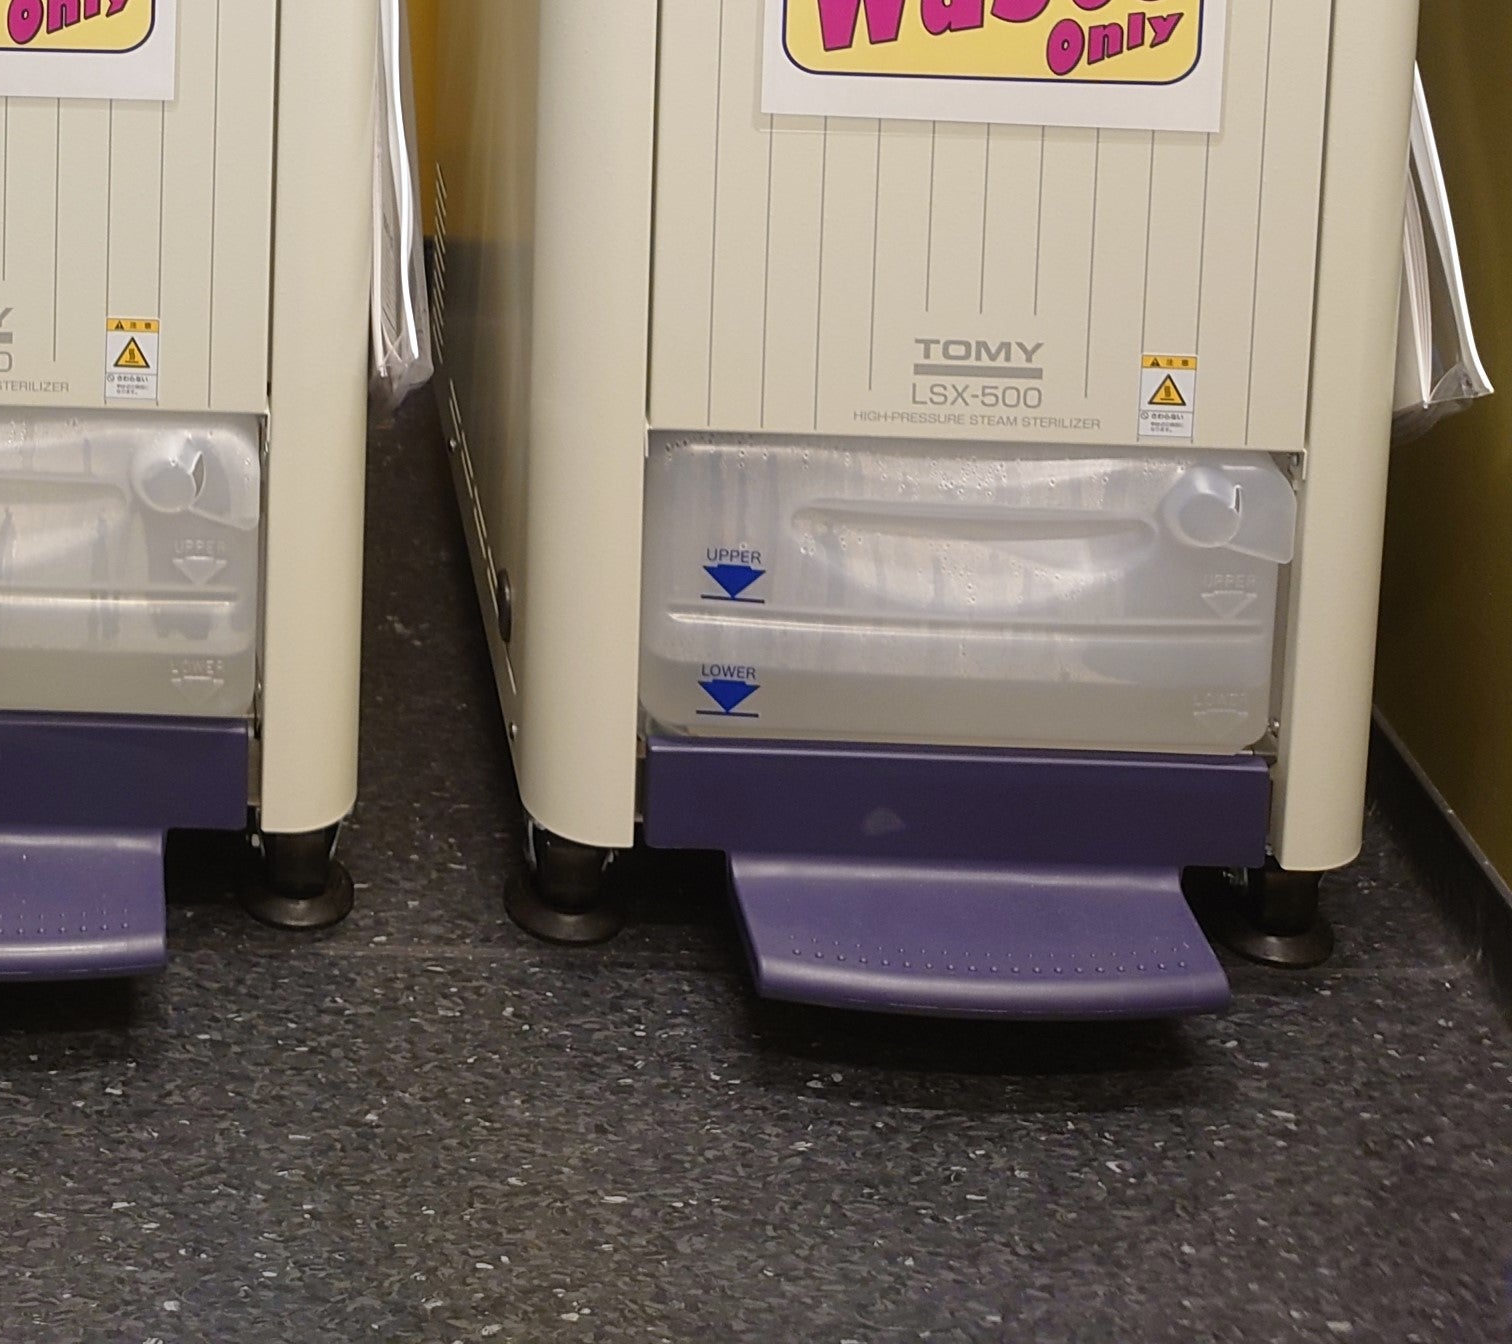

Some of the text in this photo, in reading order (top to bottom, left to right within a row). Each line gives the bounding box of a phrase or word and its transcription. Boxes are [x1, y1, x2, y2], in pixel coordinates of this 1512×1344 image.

[1046, 12, 1184, 76] Only
[914, 338, 1044, 364] TOMY
[912, 383, 1043, 408] LSX-500
[854, 411, 1101, 429] HIGH-PRESSURE STEAM STERILIZER
[707, 548, 762, 564] UPPER
[701, 664, 756, 679] LOWER
